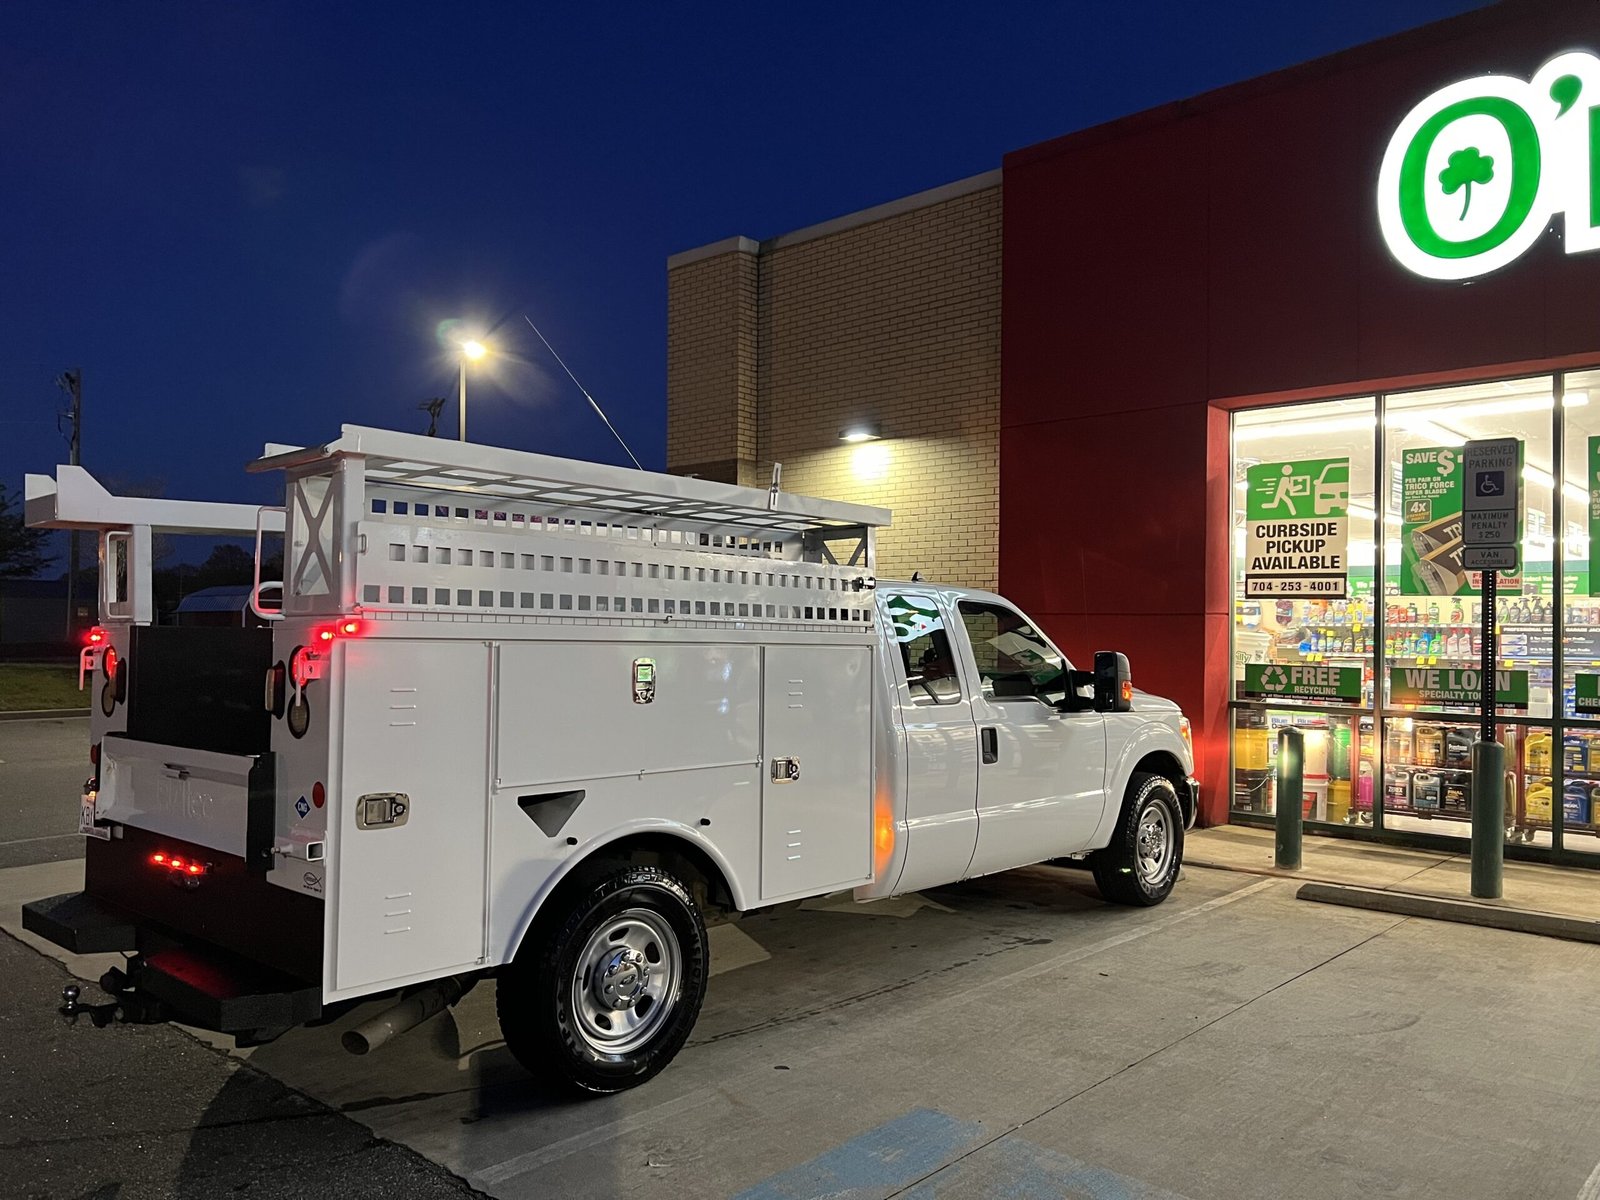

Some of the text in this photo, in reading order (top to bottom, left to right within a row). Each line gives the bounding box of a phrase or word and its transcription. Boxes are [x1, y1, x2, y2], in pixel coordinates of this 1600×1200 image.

[1466, 445, 1515, 456] RESERVED
[1405, 452, 1437, 464] SAVE
[1469, 457, 1512, 468] PARKING
[1430, 481, 1455, 489] FORCE
[1471, 512, 1508, 520] MAXIMUM
[1255, 522, 1337, 538] CURBSIDE
[1478, 531, 1500, 539] $250
[1266, 539, 1326, 554] PICKUP
[1251, 555, 1340, 570] AVAILABLE
[1252, 581, 1339, 591] 704-253-4001
[1291, 666, 1340, 686] FREE
[1405, 669, 1440, 689] WE
[1294, 685, 1337, 695] RECYCLING
[1419, 690, 1481, 700] SPECIALTY TO
[1578, 697, 1600, 706] CHE
